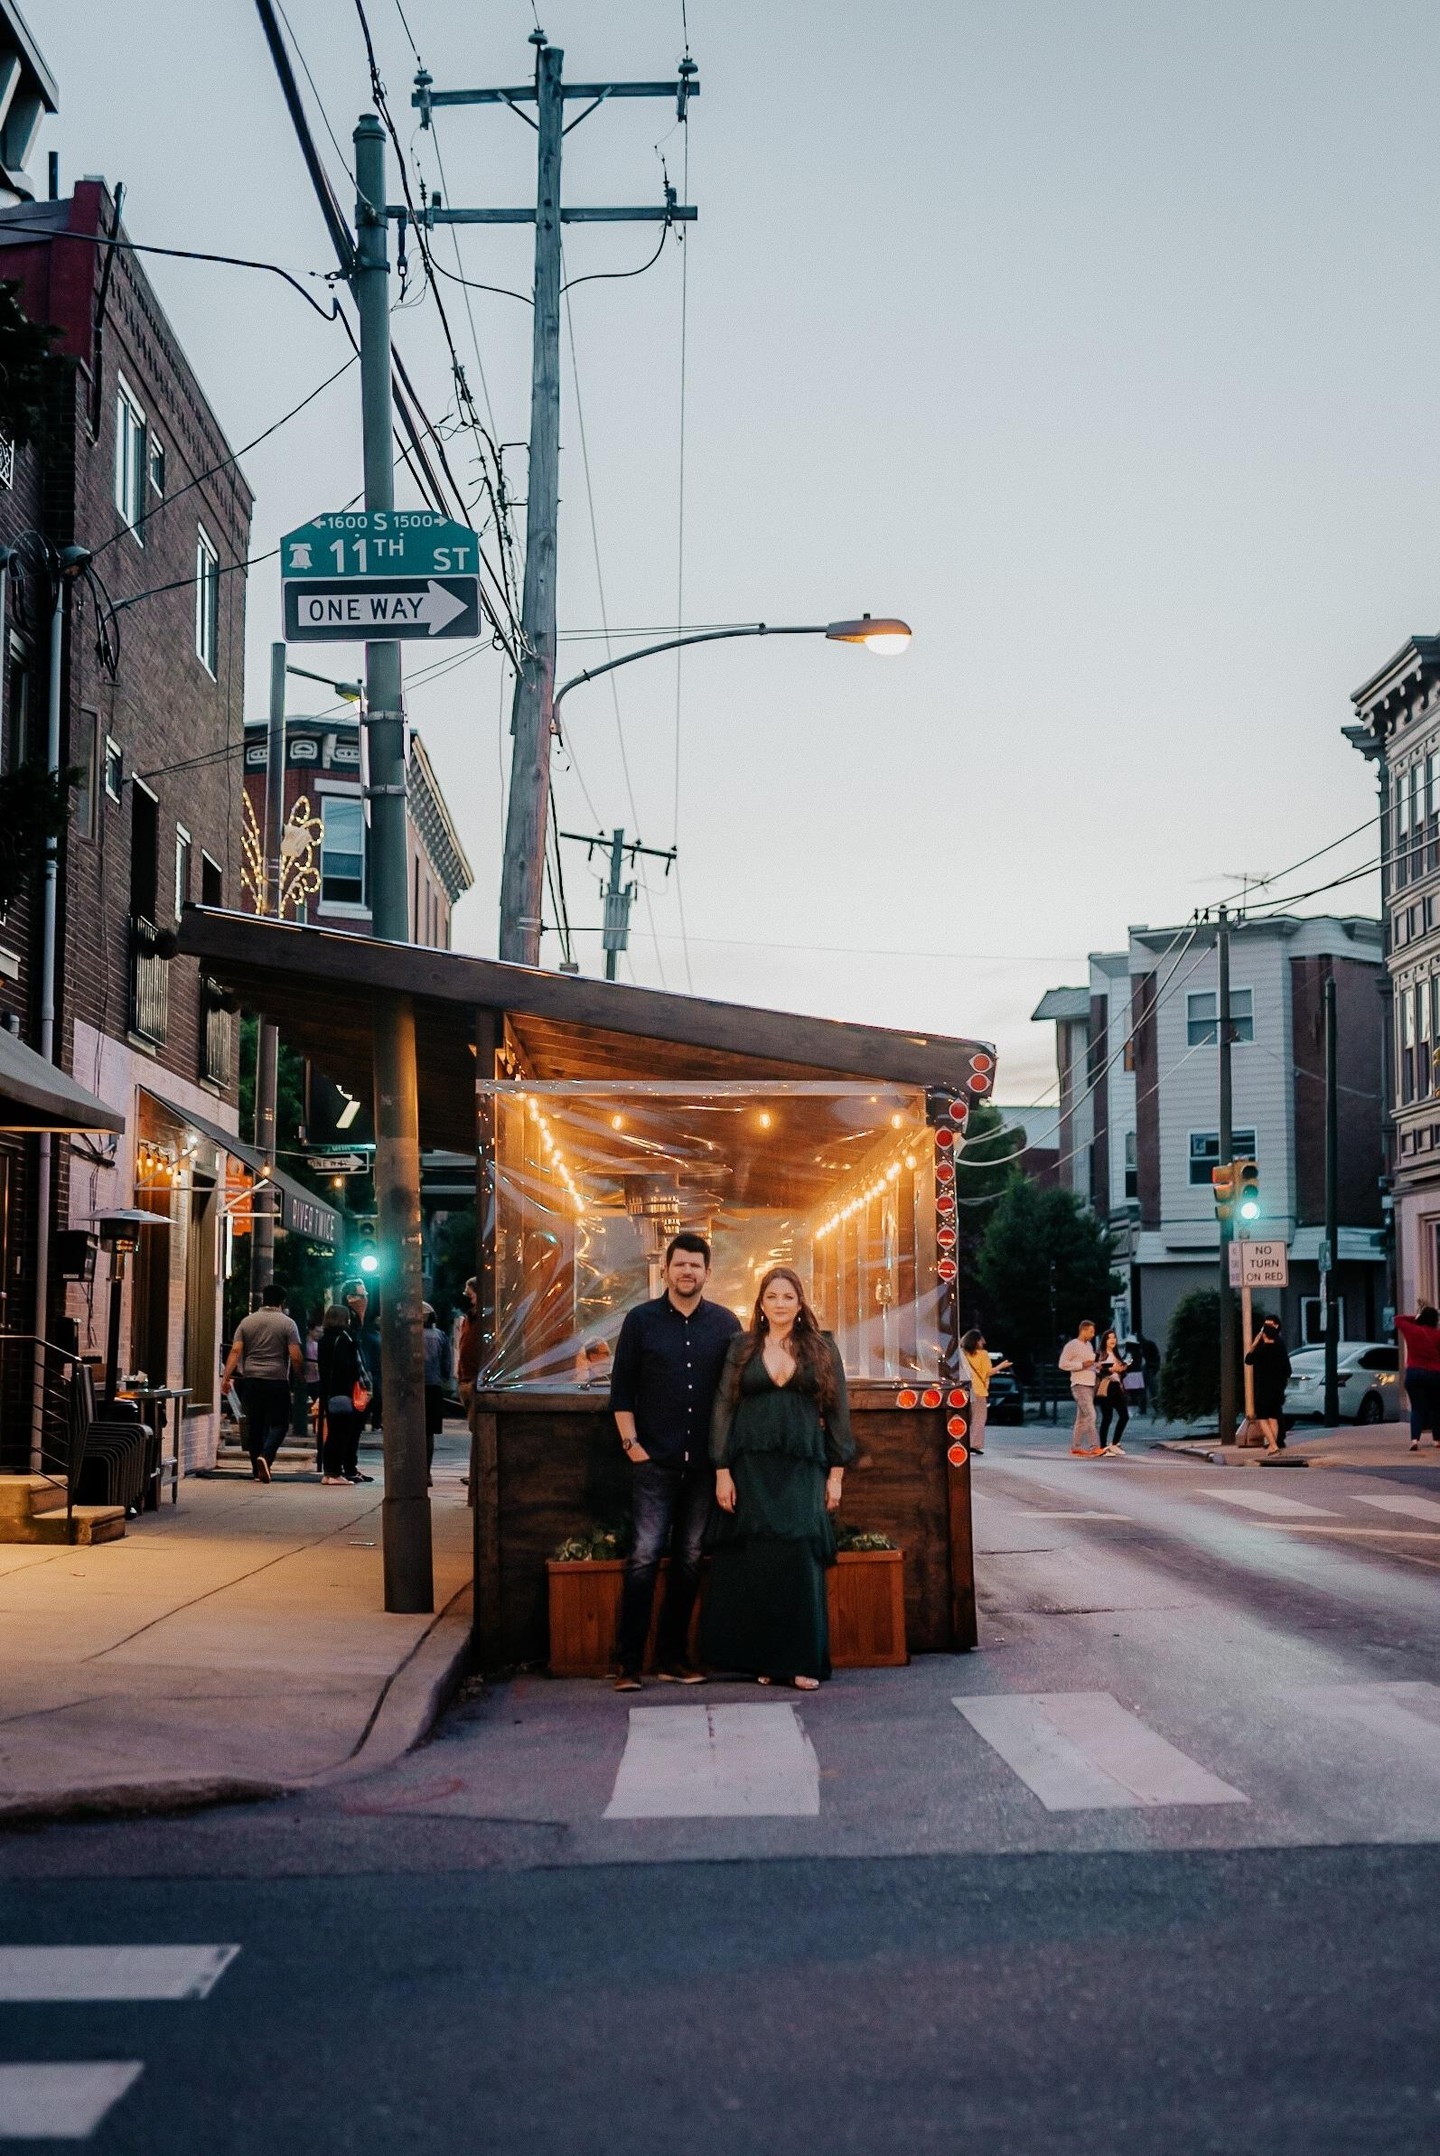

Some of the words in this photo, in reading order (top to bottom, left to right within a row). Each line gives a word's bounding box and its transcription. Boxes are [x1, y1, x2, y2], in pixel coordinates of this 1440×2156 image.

[327, 516, 368, 529] 1600
[373, 512, 388, 531] S
[393, 515, 433, 528] 1500
[329, 537, 404, 573] 11TH
[433, 547, 470, 571] ST
[309, 599, 360, 621] ONE
[370, 597, 424, 620] WAY
[292, 1199, 313, 1233] RIVER
[314, 1208, 335, 1241] TWICE
[1255, 1245, 1272, 1255] NO
[1250, 1259, 1279, 1268] TURN
[1246, 1272, 1261, 1282] ON
[1264, 1272, 1283, 1281] RED
